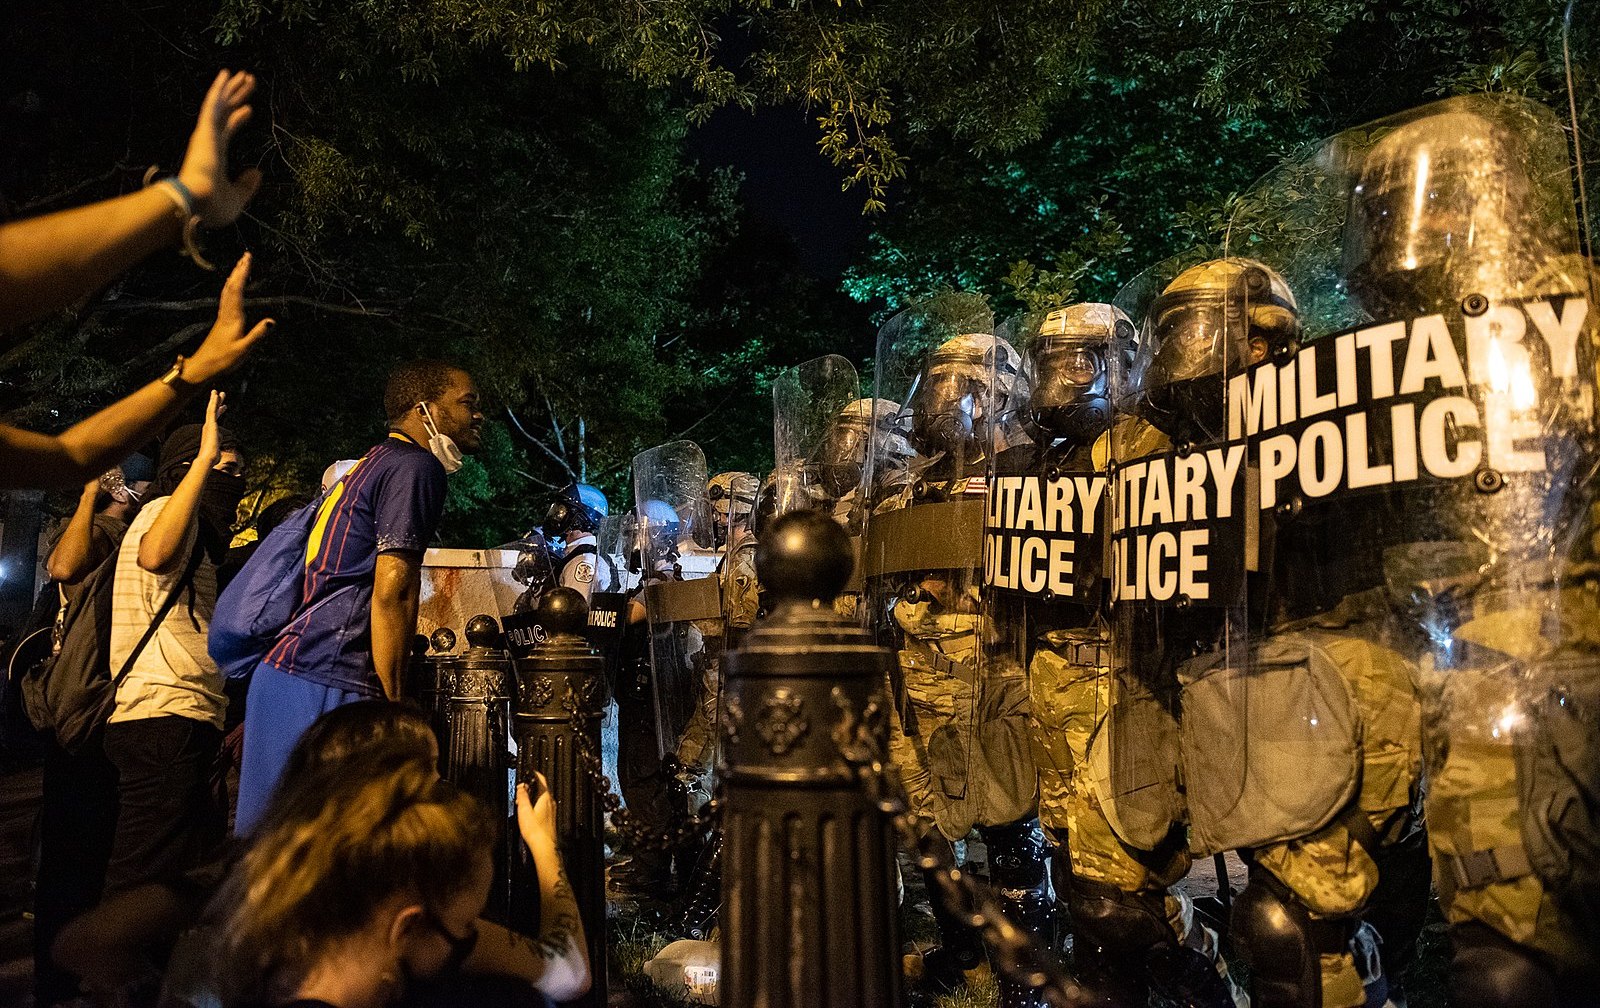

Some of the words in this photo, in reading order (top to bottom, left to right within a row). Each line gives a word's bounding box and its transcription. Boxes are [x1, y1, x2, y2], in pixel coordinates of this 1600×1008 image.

[1228, 298, 1588, 441] MILITARY
[1259, 391, 1547, 510] POLICE
[987, 476, 1107, 534] LITARY
[1112, 445, 1246, 534] LITARY
[985, 533, 1075, 597] OLICE
[1111, 529, 1209, 602] OLICE
[508, 624, 548, 647] POLIC
[594, 611, 617, 628] POLICE
